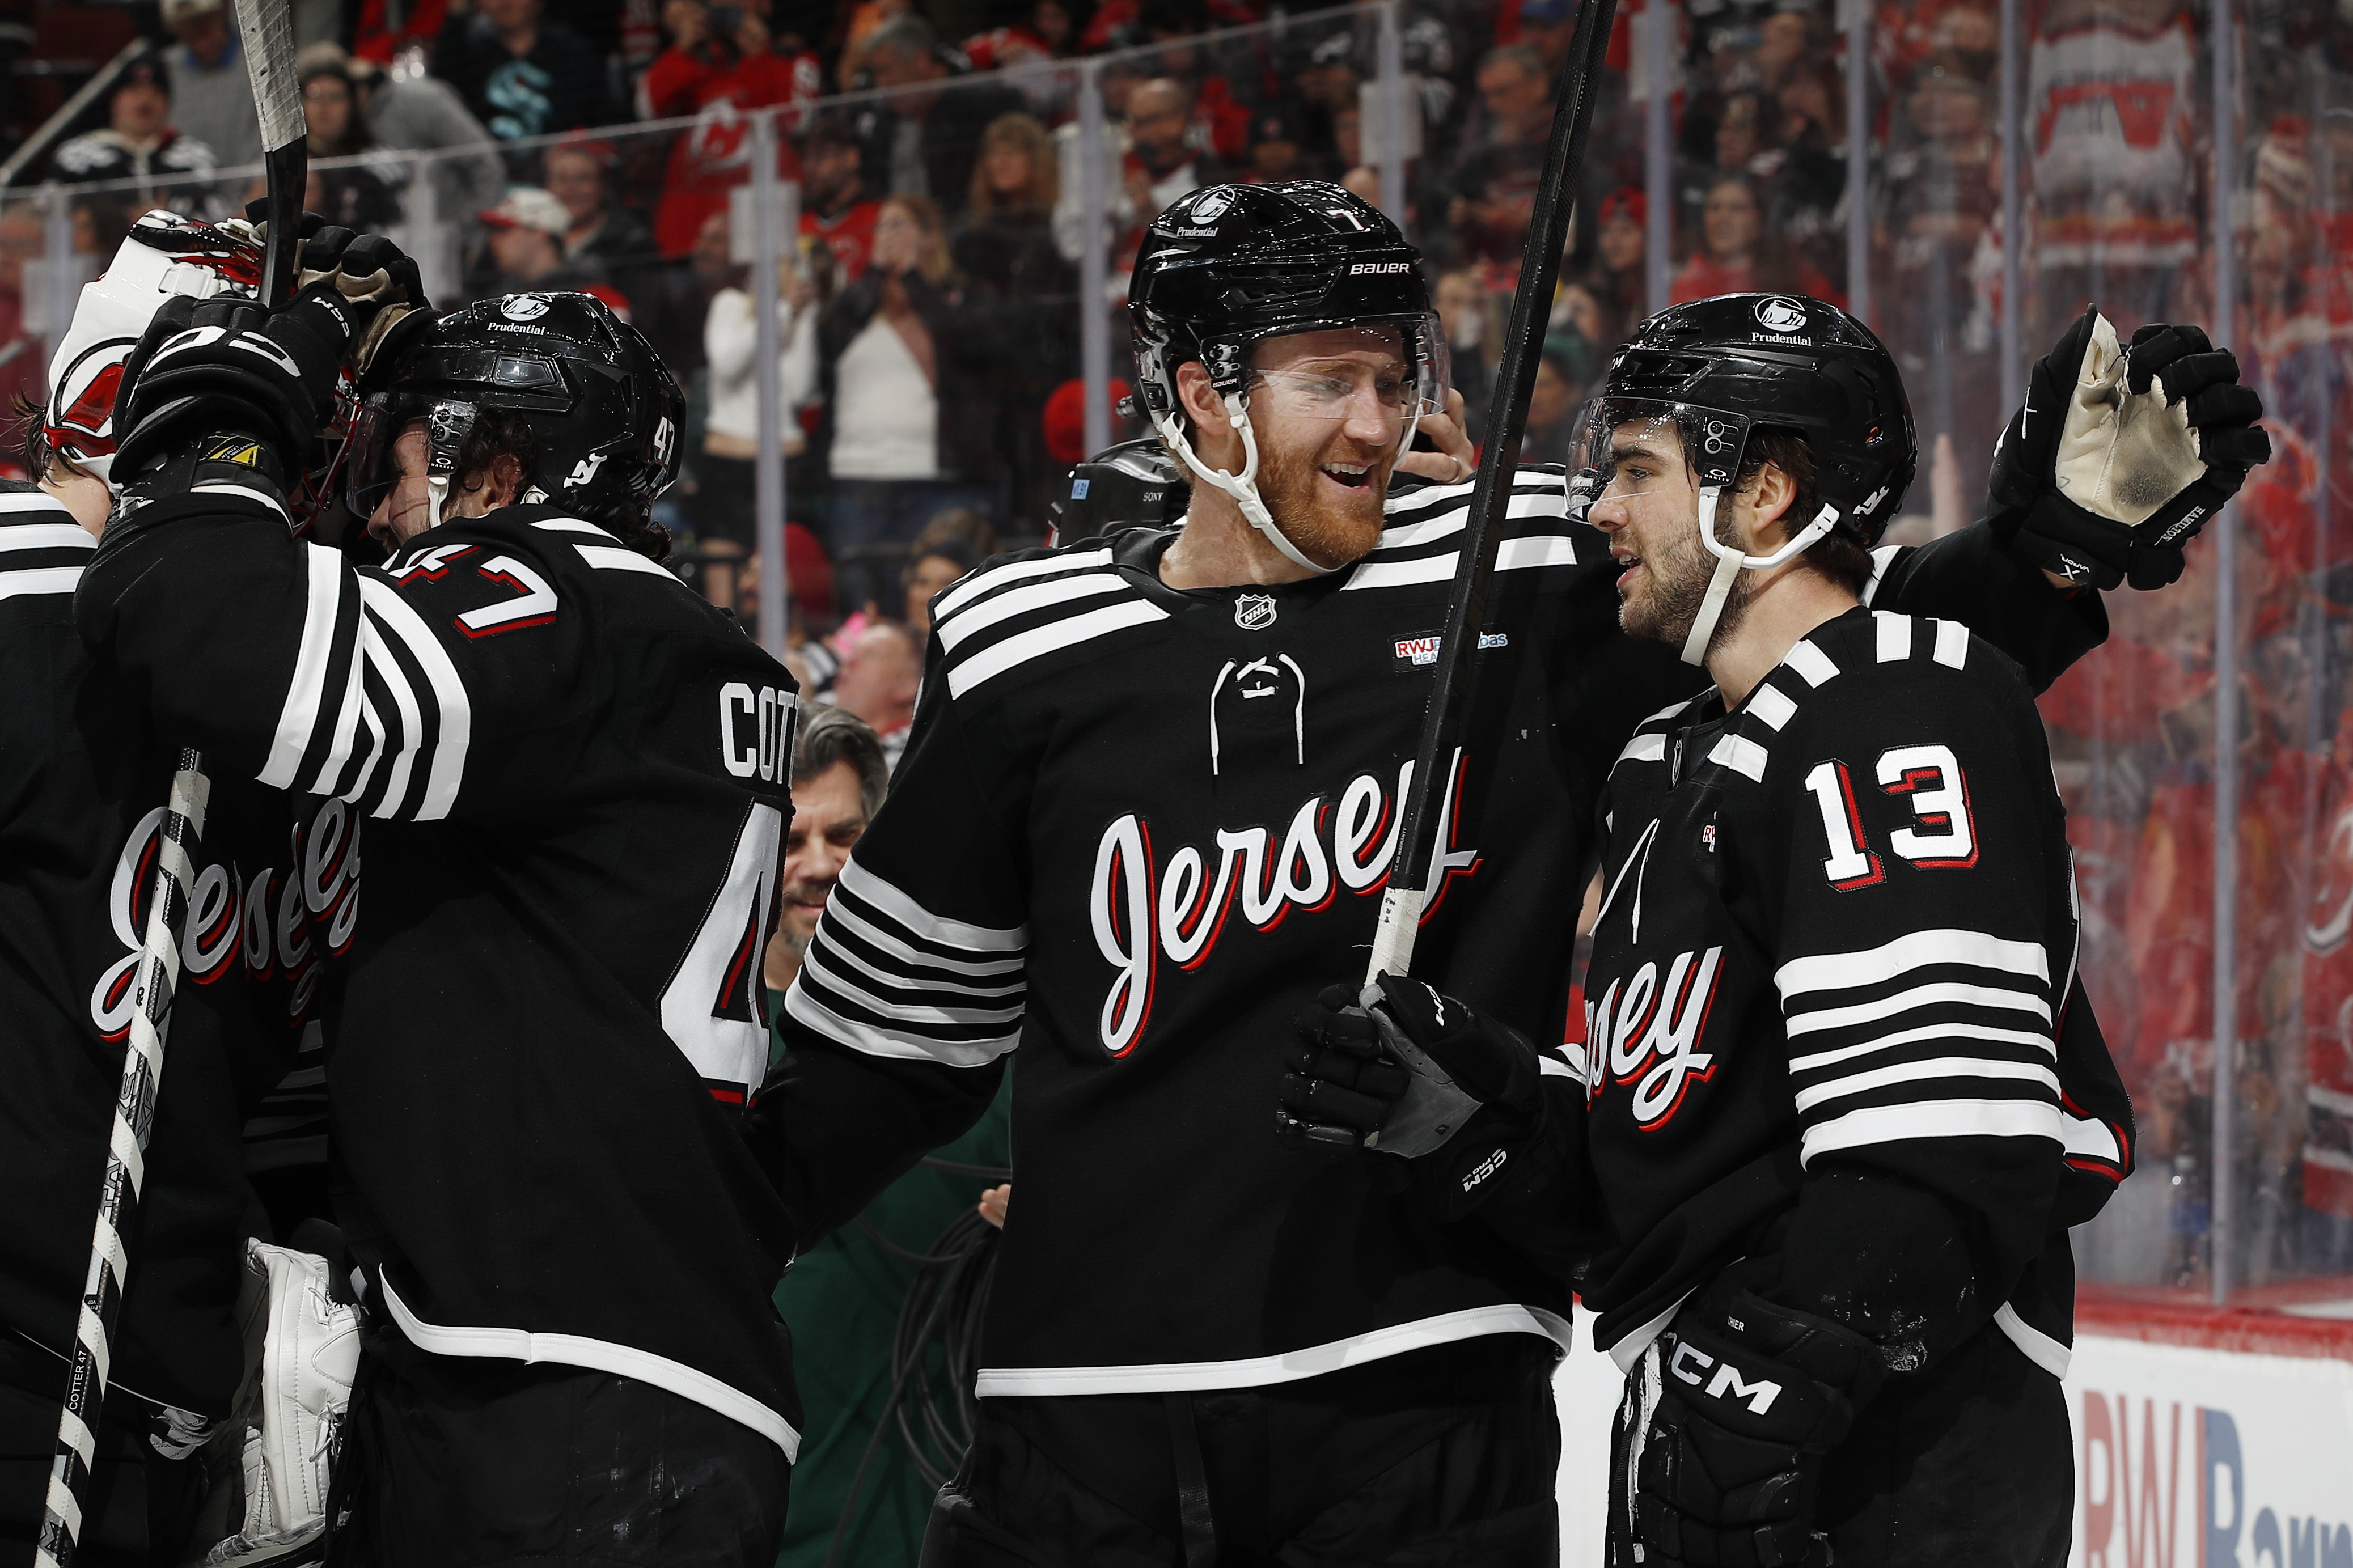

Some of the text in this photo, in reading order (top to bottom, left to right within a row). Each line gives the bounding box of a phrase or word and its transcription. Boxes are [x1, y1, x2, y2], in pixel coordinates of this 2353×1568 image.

[1176, 226, 1218, 238] Prudential
[1349, 262, 1410, 276] BAUER
[486, 321, 545, 336] Prudential
[1751, 332, 1812, 347] Prudential
[1212, 378, 1238, 388] BAUER
[1704, 473, 1730, 483] OAKLEY
[1142, 491, 1163, 502] SONY
[2161, 505, 2206, 542] HAMILTON
[2060, 553, 2090, 573] VAPOR
[1804, 744, 1978, 892] 13
[1396, 855, 1401, 864] NO
[1463, 1150, 1507, 1192] CCM
[1472, 1157, 1491, 1175] PRO
[69, 1350, 87, 1410] COTTER 47
